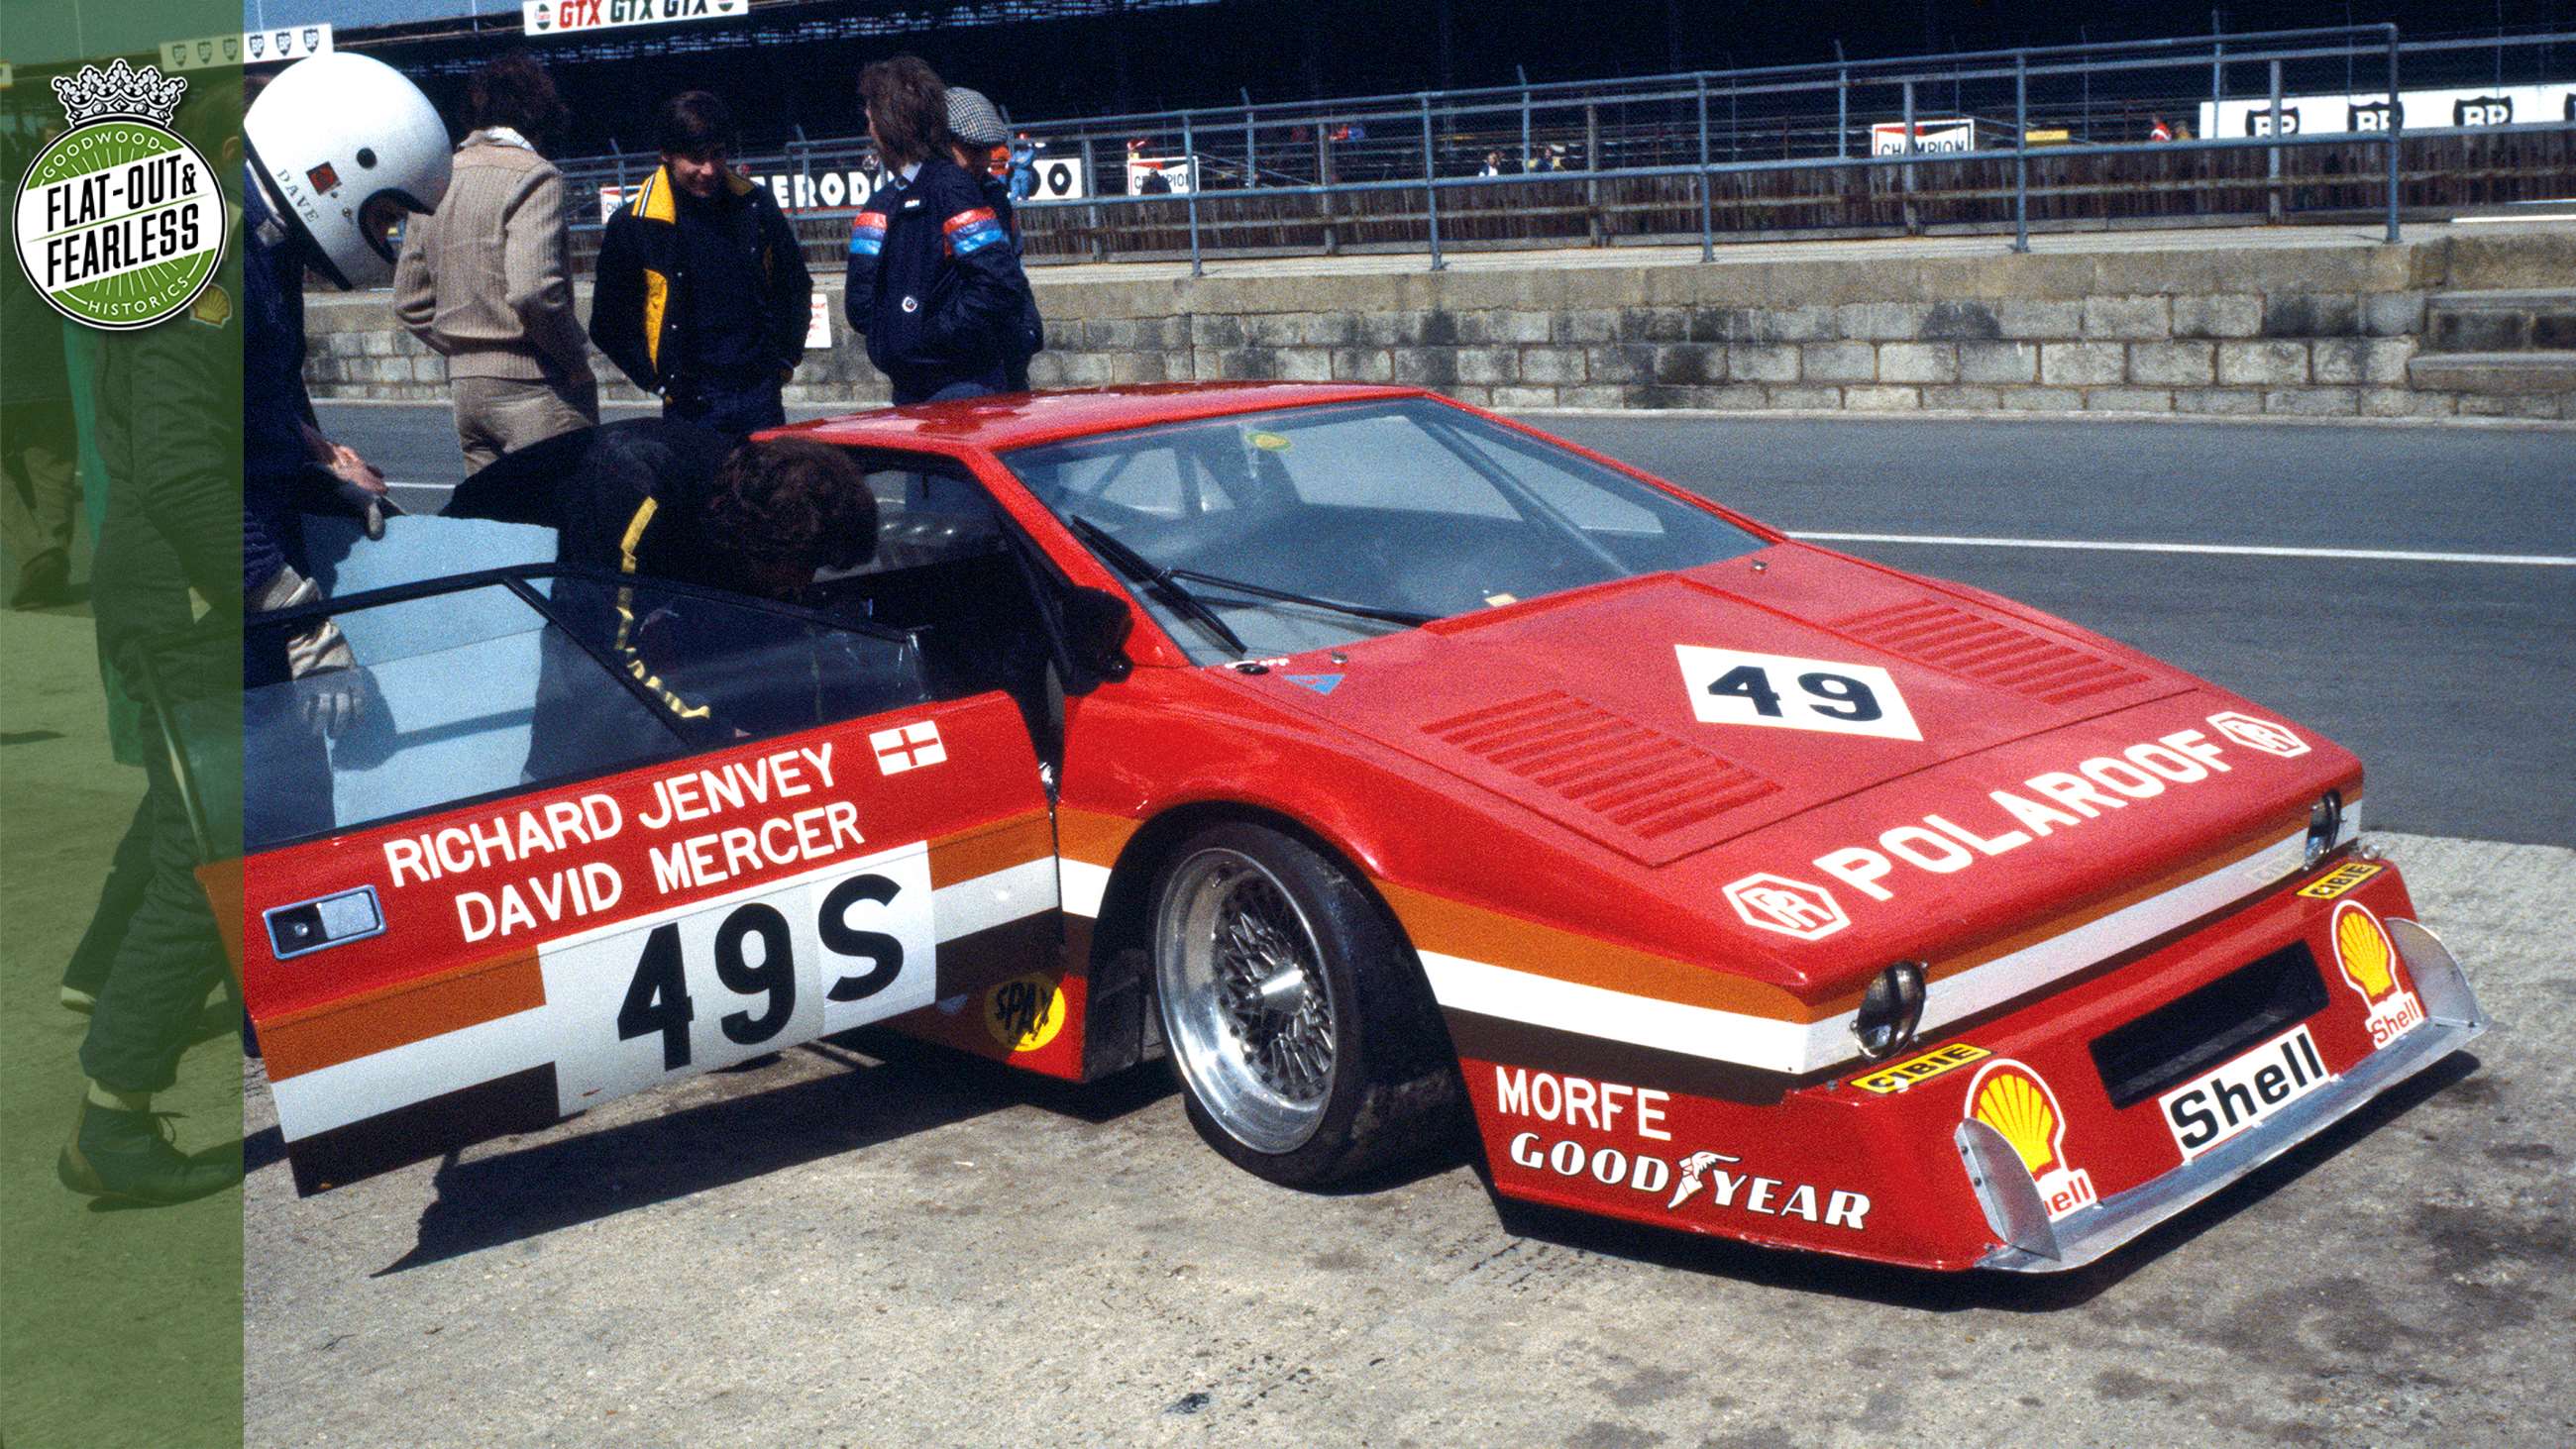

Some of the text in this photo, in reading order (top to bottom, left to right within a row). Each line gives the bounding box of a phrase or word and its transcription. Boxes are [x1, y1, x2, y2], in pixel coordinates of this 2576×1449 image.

[559, 0, 601, 29] GTX
[610, 0, 654, 23] GTX
[276, 169, 319, 222] DAVE
[1707, 666, 1883, 722] 49
[383, 742, 834, 887] RICHARD JENVEY
[1812, 729, 2232, 901] POLAROOF
[455, 801, 865, 943] DAVID MERCER
[2372, 998, 2419, 1044] Shell
[1496, 1066, 1671, 1140] MORFE
[2170, 1032, 2324, 1150] Shell
